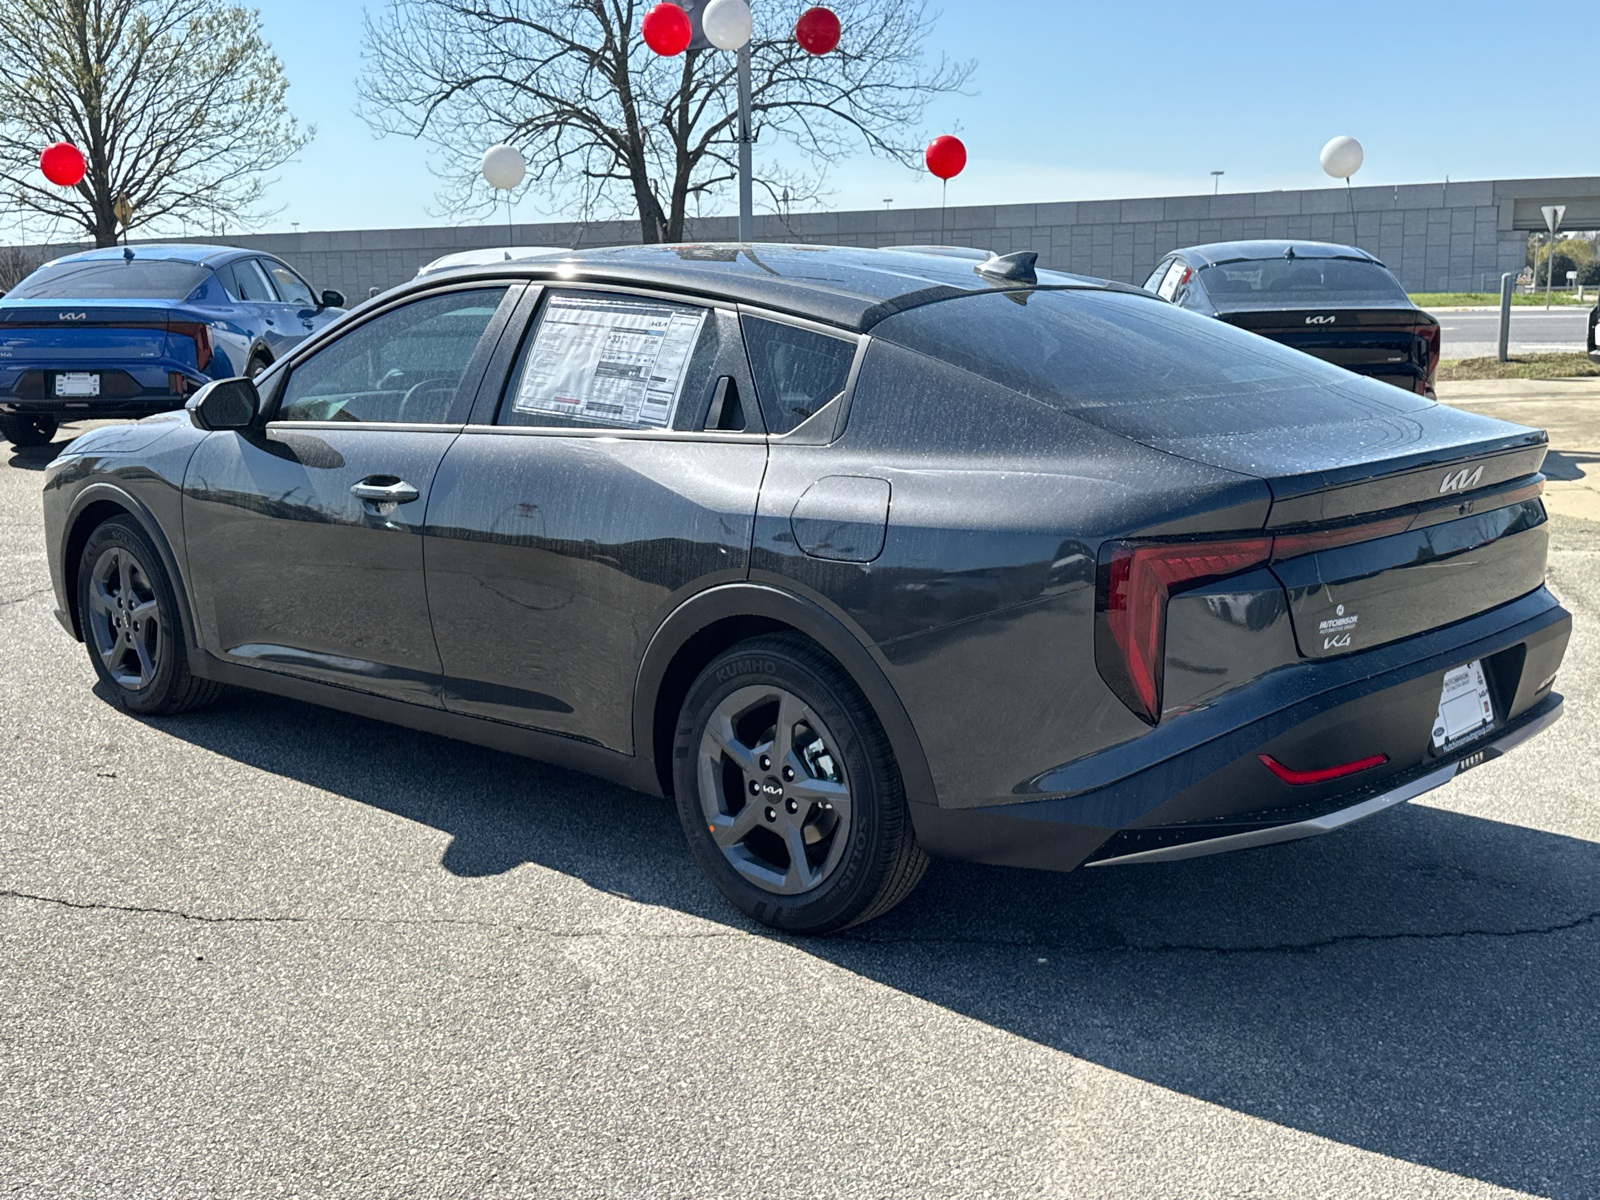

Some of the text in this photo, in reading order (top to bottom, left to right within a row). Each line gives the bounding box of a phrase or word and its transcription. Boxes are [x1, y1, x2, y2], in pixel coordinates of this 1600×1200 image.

[59, 312, 87, 321] KIA
[1305, 315, 1336, 325] KIA
[1439, 465, 1484, 493] KIA
[1319, 614, 1359, 630] HUTCHINSON
[1323, 633, 1351, 650] K4
[716, 660, 777, 684] KUMHO
[762, 784, 783, 796] KIA
[839, 815, 867, 891] SOLUS
